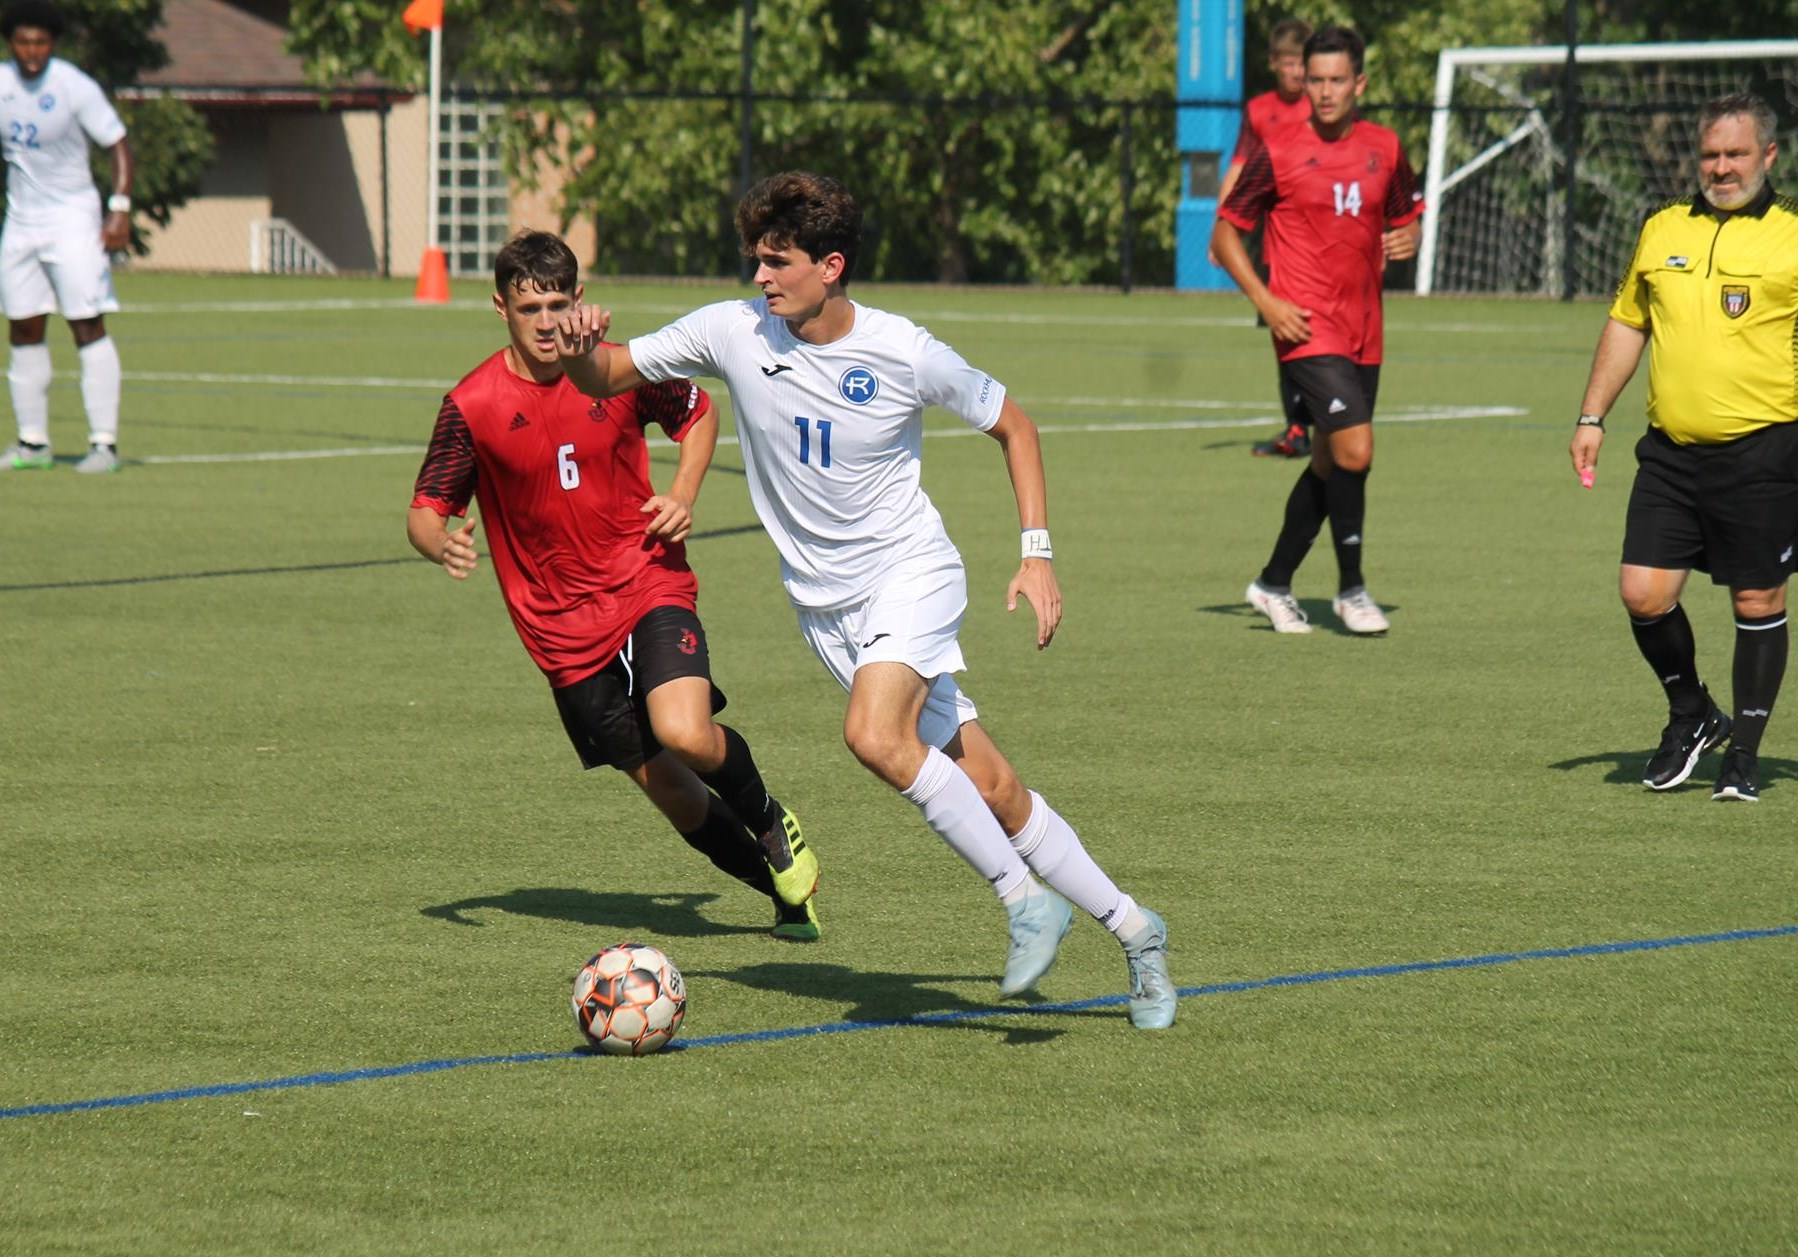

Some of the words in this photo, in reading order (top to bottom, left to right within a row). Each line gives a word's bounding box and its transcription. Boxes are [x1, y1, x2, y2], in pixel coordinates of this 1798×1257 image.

[9, 121, 41, 149] 22
[1333, 182, 1362, 216] 14
[794, 416, 831, 468] 11
[557, 443, 580, 490] 6
